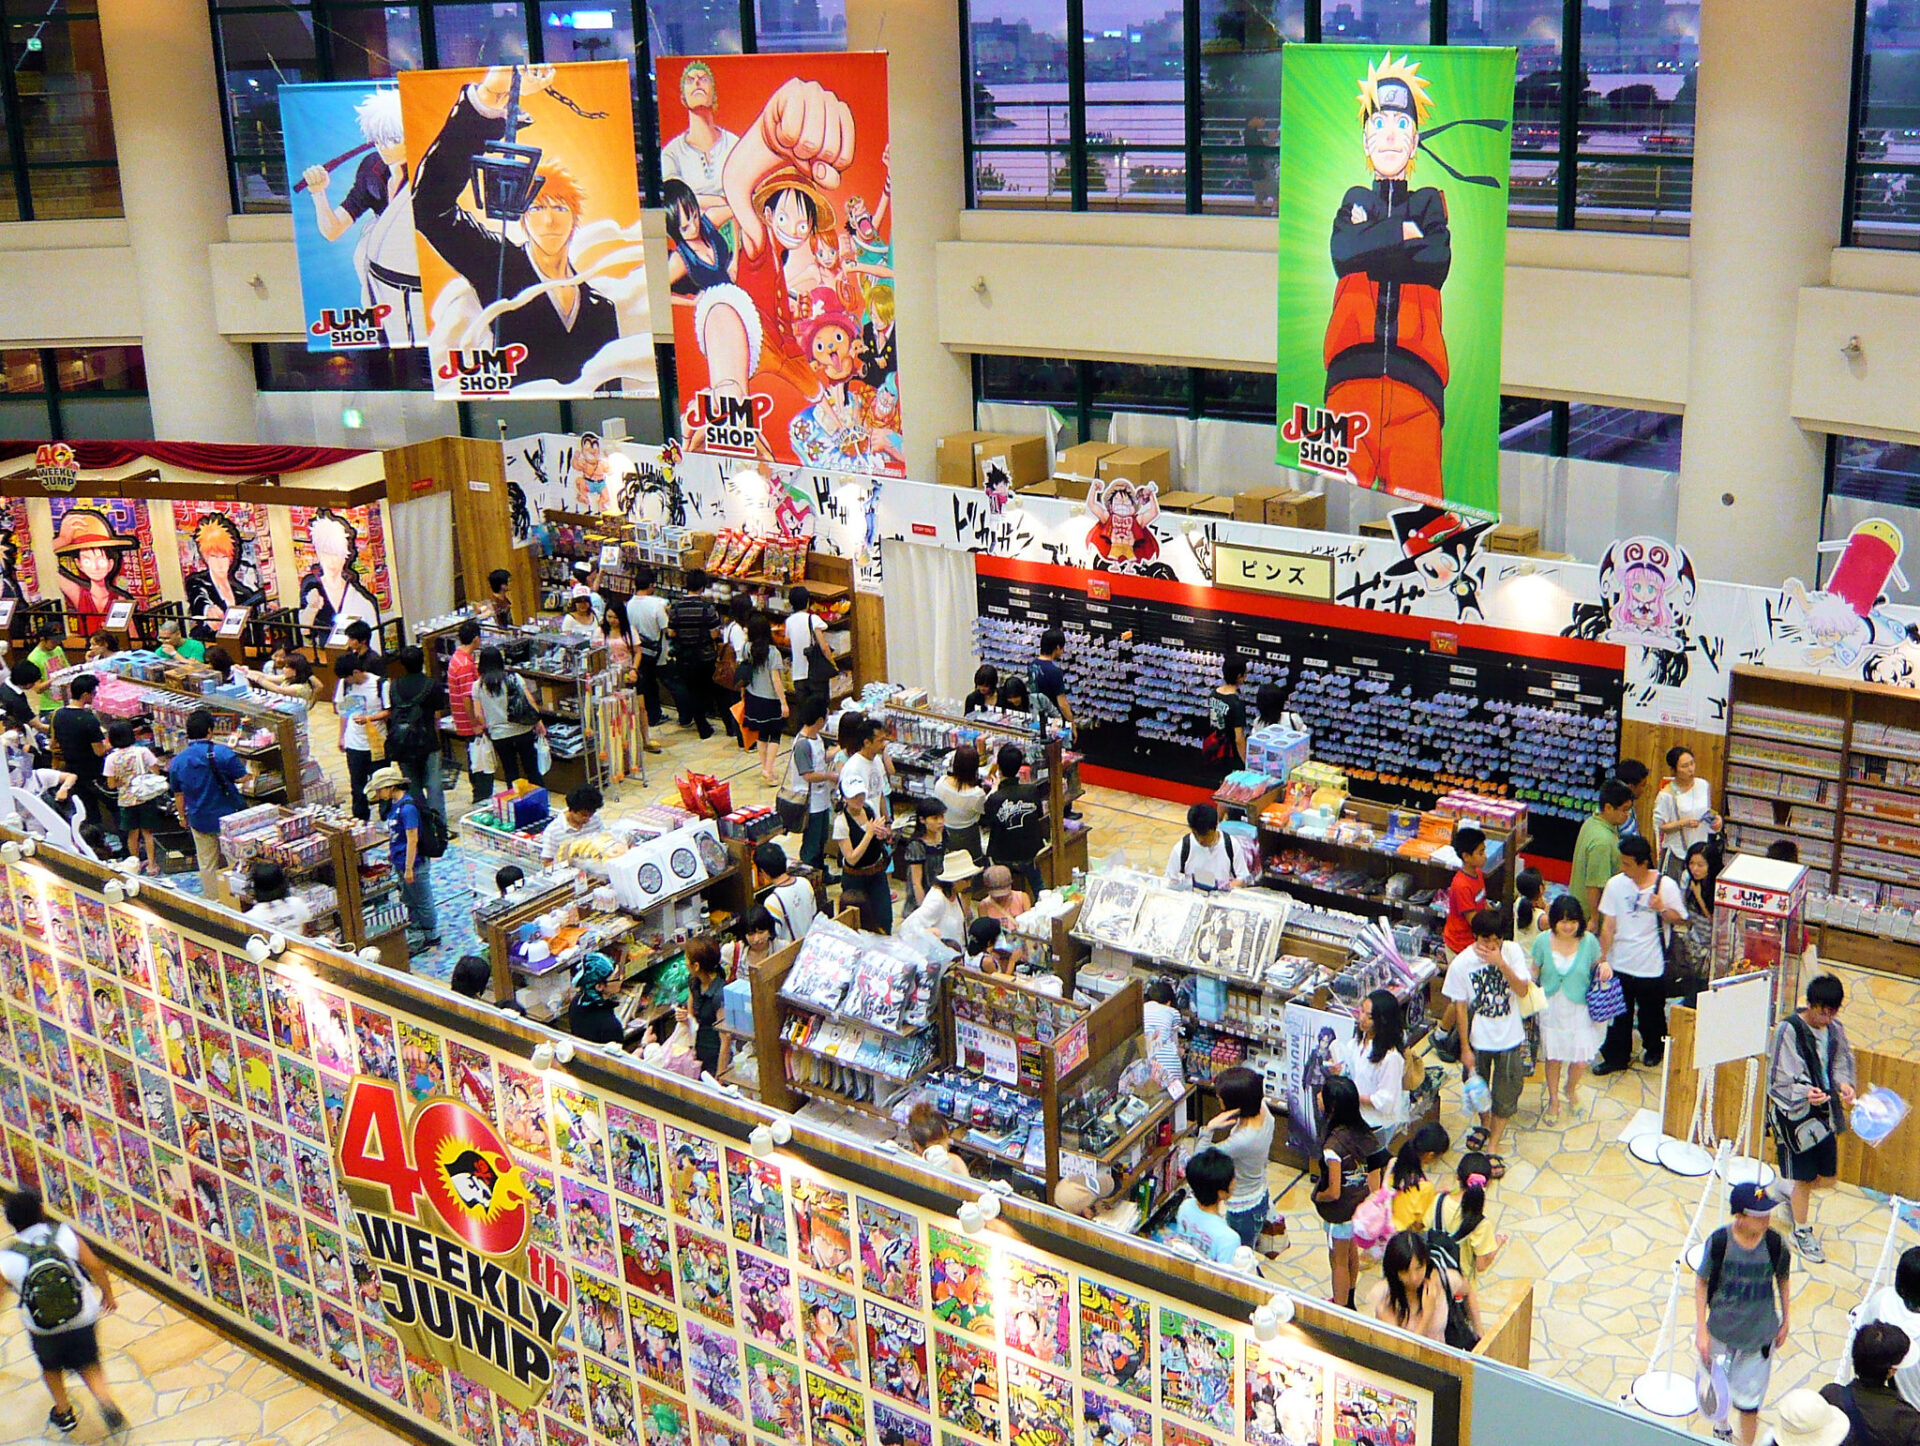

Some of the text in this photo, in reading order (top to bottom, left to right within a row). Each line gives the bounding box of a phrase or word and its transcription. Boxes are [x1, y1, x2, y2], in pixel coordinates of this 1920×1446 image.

[311, 305, 391, 334] JUMP
[332, 330, 376, 341] SHOP
[438, 345, 526, 379] JUMP
[460, 376, 509, 390] SHOP
[687, 394, 771, 430] JUMP
[707, 427, 754, 447] SHOP
[1282, 405, 1368, 449] JUMP
[1300, 441, 1347, 467] SHOP
[39, 468, 76, 477] WEEKLY
[43, 477, 74, 486] JUMP
[1242, 560, 1305, 585] ピンズ
[1733, 890, 1773, 904] JUMP
[1741, 901, 1763, 909] SHOP
[1291, 1035, 1300, 1106] MUKURO
[341, 1083, 527, 1254] 40
[357, 1213, 563, 1344] WEEKLY
[528, 1246, 568, 1304] th
[381, 1268, 551, 1383] JUMP
